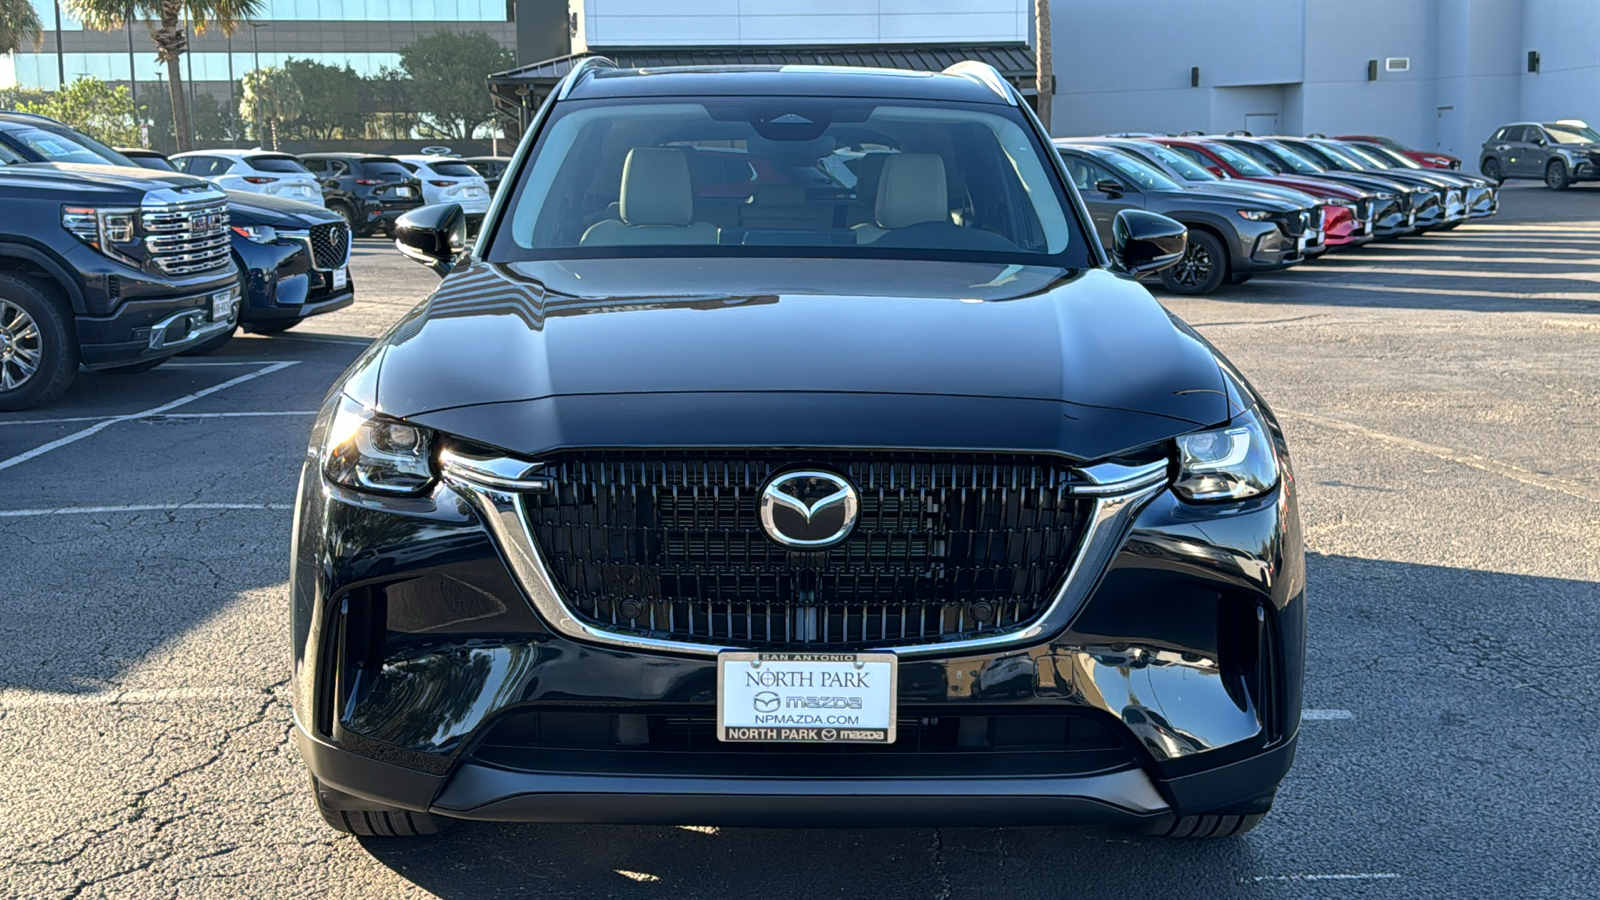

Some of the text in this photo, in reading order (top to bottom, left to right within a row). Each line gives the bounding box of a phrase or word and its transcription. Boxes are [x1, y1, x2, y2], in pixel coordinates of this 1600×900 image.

[745, 669, 871, 689] NORTH PARK
[786, 696, 863, 710] mazda
[755, 714, 859, 725] NPMAZDA.COM
[728, 728, 885, 740] NORTH PARK mazda
